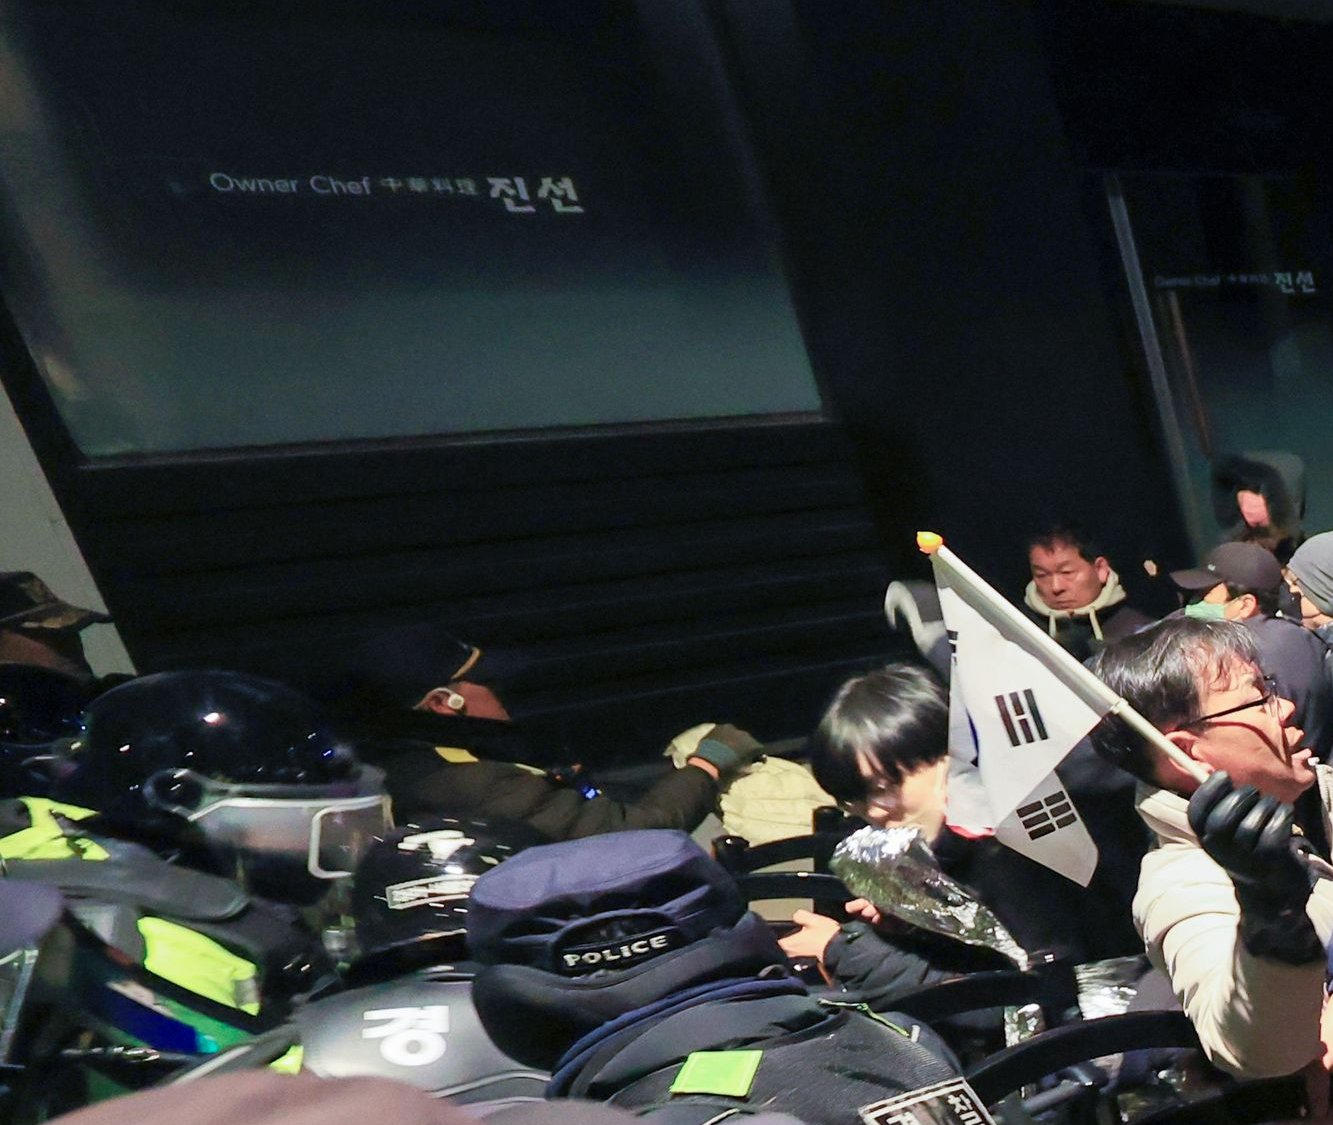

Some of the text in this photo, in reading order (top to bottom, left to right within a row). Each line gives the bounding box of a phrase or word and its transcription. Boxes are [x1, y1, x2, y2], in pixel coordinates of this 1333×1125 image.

[209, 172, 299, 195] Owner
[309, 174, 372, 196] Chef
[486, 175, 585, 214] 진선
[563, 934, 669, 967] POLICE
[361, 1004, 450, 1067] 경
